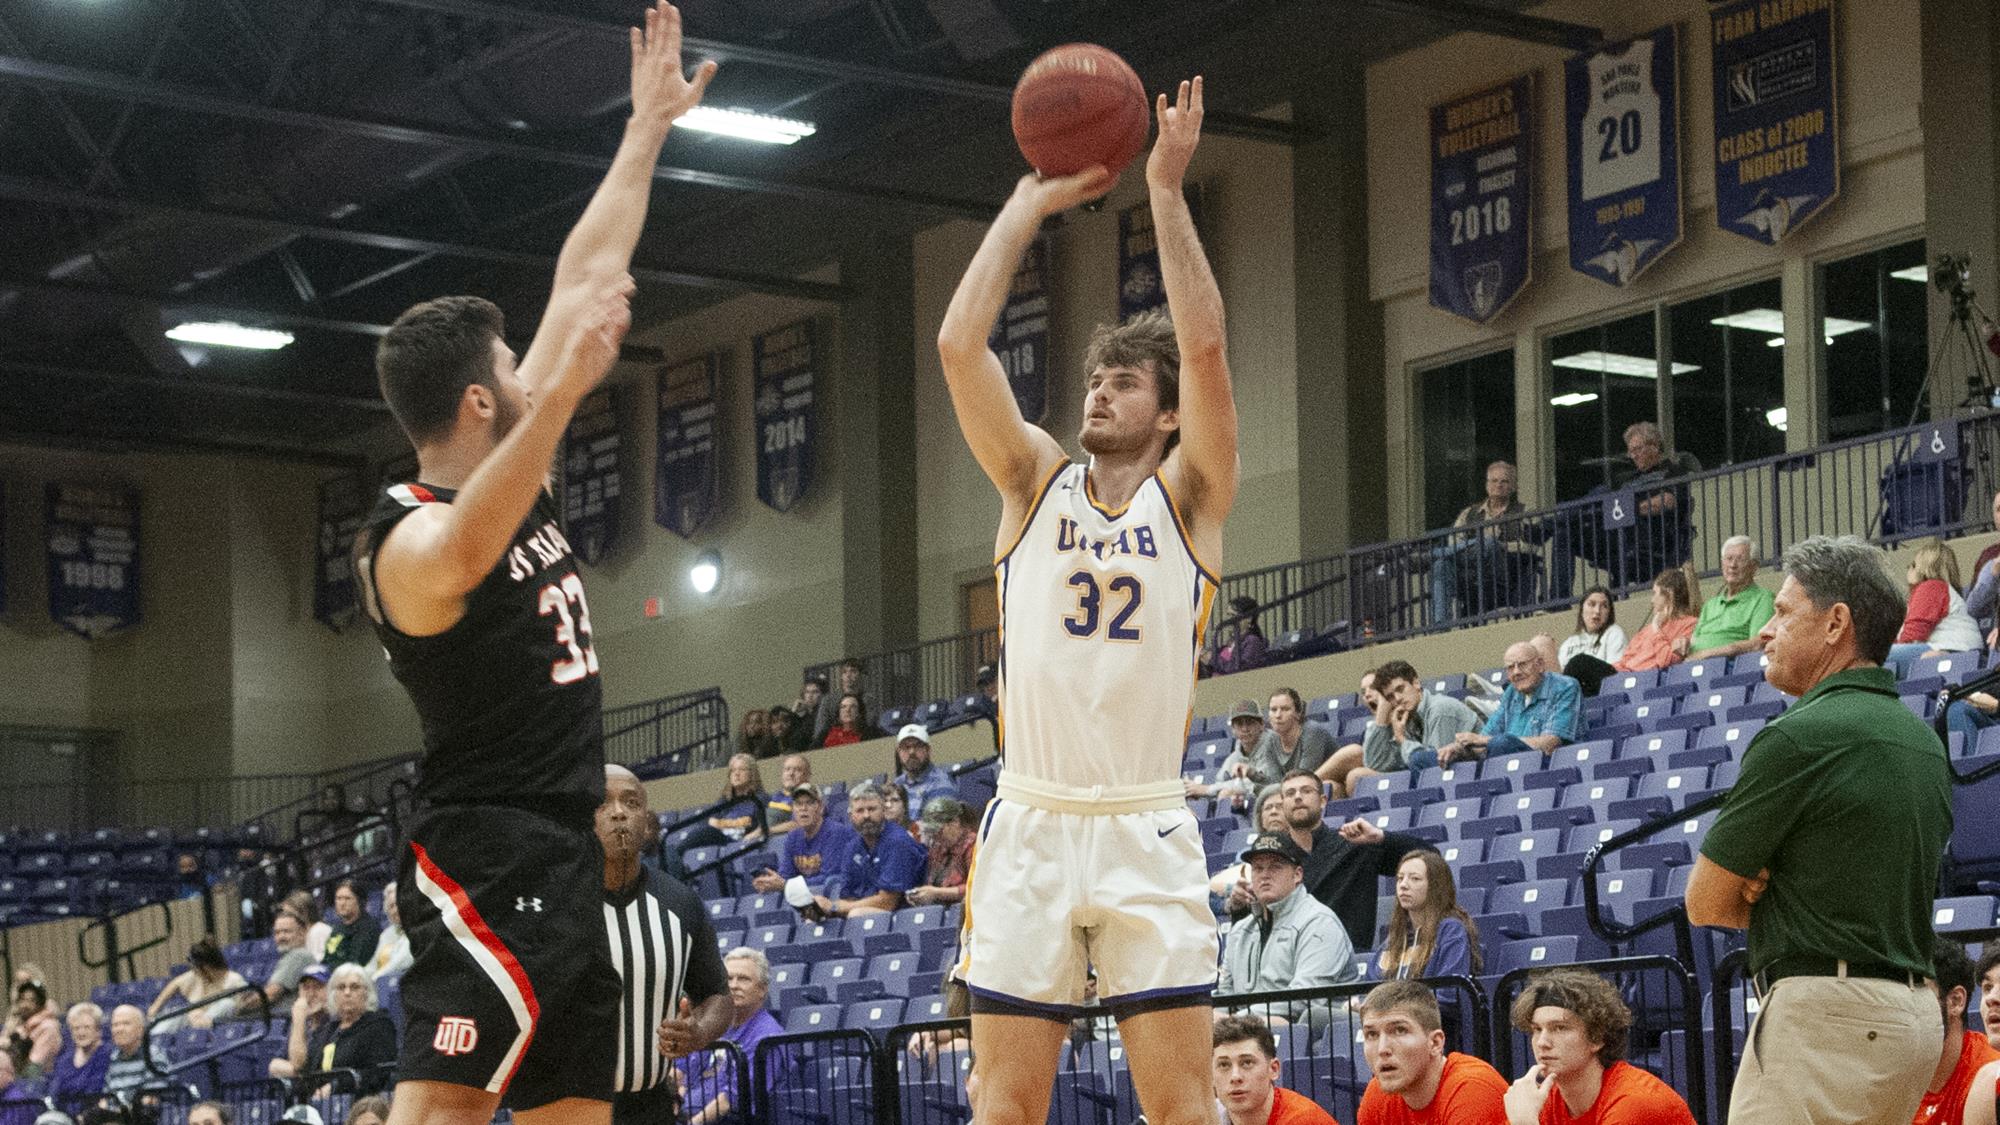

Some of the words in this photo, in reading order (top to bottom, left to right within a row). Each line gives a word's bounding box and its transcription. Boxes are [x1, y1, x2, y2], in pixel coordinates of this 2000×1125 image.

[1598, 109, 1641, 163] 20
[1719, 127, 1764, 164] CLASS
[1739, 141, 1809, 185] INDUCTEE
[1450, 196, 1512, 246] 2018
[999, 343, 1035, 378] 018
[764, 415, 806, 454] 2014
[1062, 569, 1144, 643] 32
[432, 1014, 480, 1057] UTD
